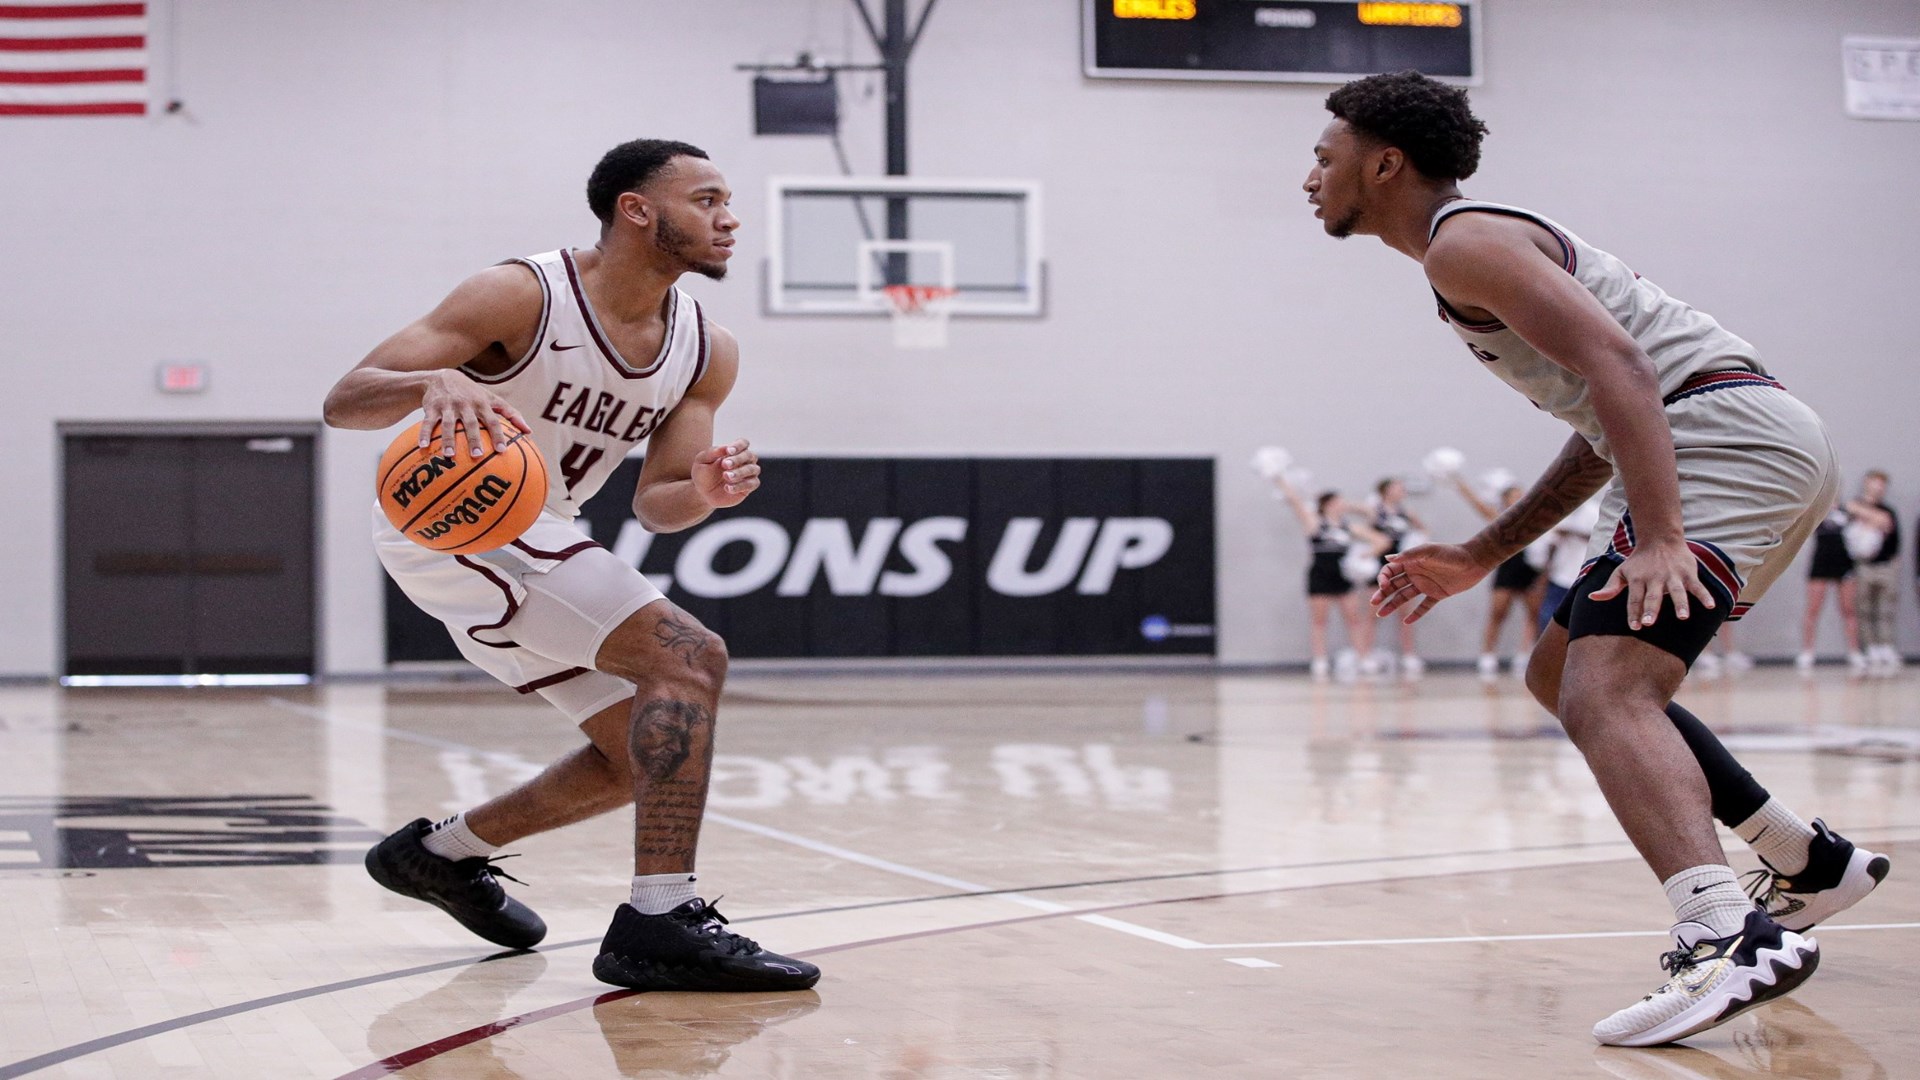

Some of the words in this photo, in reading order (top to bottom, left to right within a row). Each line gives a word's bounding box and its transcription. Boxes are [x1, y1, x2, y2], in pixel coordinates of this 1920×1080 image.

[541, 381, 667, 443] EAGLES
[391, 454, 457, 510] NCAA
[560, 442, 605, 500] 4
[415, 473, 513, 542] Wilson
[574, 516, 968, 598] LONS
[986, 516, 1175, 597] UP
